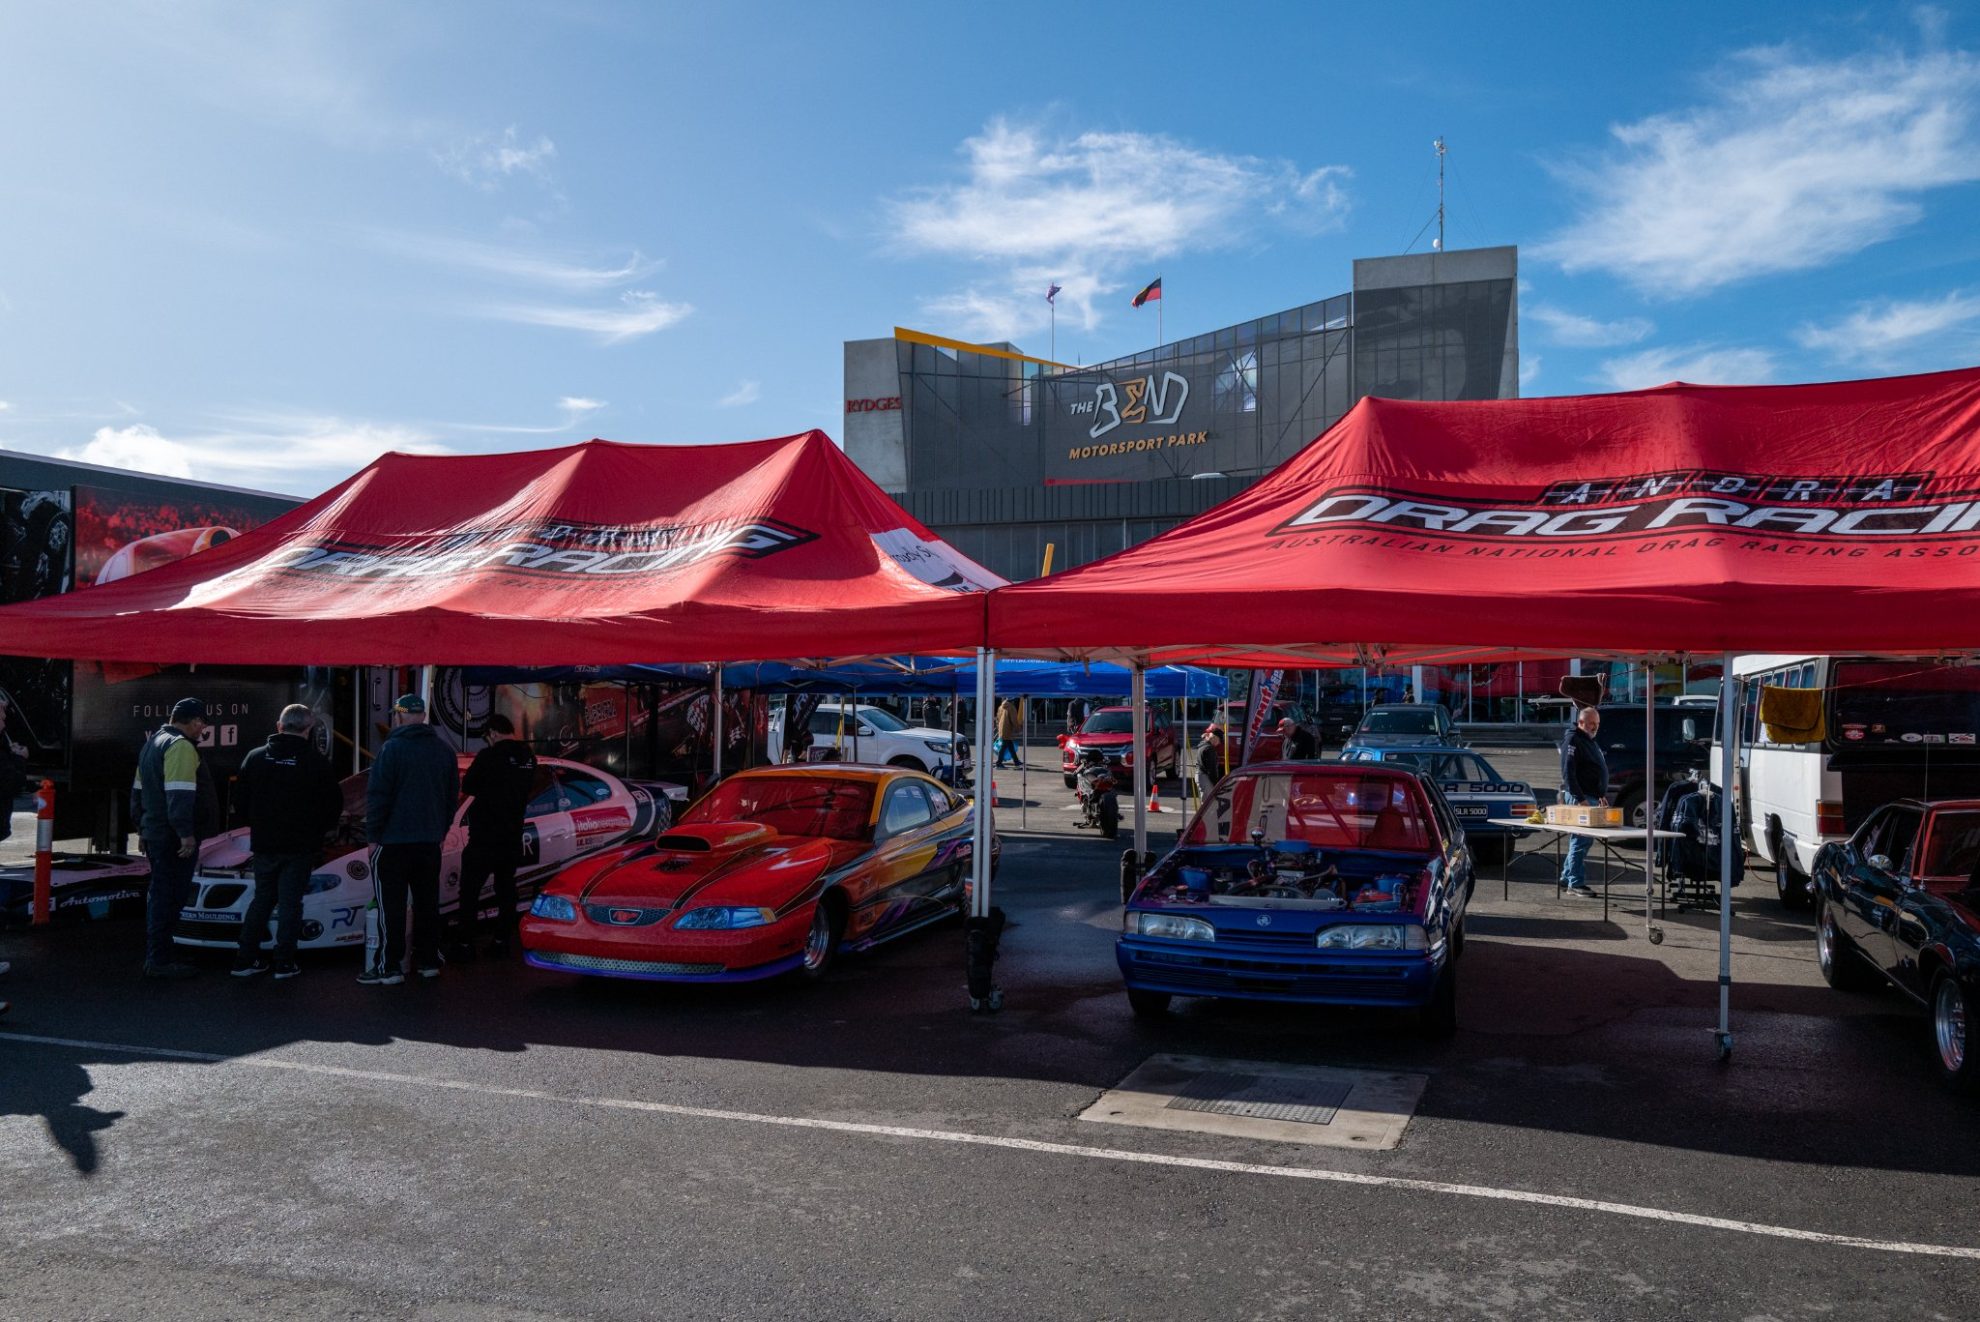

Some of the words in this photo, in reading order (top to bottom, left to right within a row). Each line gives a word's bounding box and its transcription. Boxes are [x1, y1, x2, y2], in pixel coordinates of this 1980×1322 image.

[846, 397, 902, 413] RYDGES
[1070, 401, 1095, 415] THE
[1068, 436, 1164, 460] MOTORSPORT
[1168, 431, 1208, 447] PARK
[1558, 476, 1895, 504] ANDRA
[1288, 495, 1641, 536] DRAG
[1268, 534, 1455, 553] AUSTRALIAN
[1465, 544, 1618, 558] NATIONAL
[1637, 537, 1725, 553] DRAG
[1738, 540, 1870, 558] RACING
[133, 704, 171, 718] FOLL
[206, 704, 223, 716] US
[231, 703, 249, 715] ON
[1469, 783, 1524, 792] 5000
[1455, 807, 1469, 815] SLR
[1470, 807, 1487, 815] 5000
[60, 890, 141, 908] Automotive
